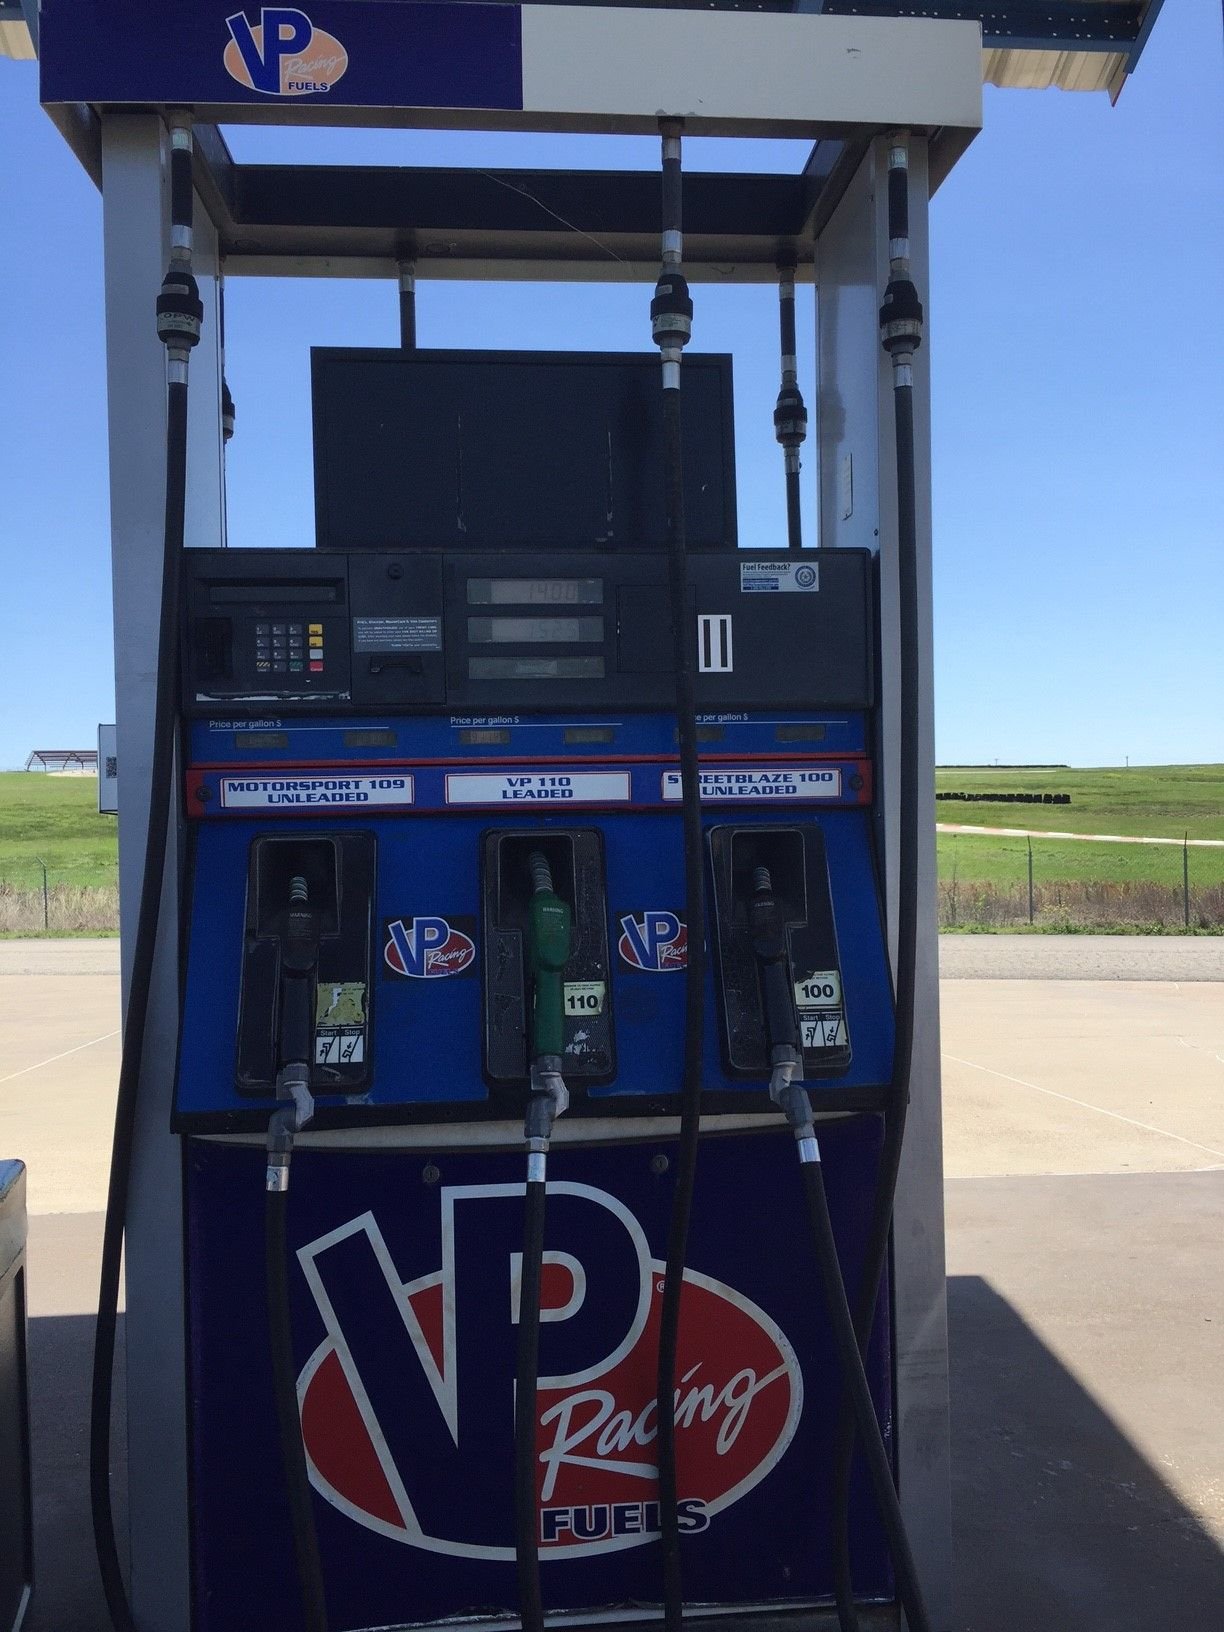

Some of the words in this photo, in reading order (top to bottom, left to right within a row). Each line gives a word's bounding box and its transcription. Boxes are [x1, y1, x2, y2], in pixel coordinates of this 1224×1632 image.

[226, 8, 312, 94] VP
[288, 82, 328, 91] FUELS
[757, 563, 791, 571] Feedback?
[450, 717, 471, 725] Price
[473, 717, 487, 726] per
[488, 716, 513, 726] gallon
[514, 715, 520, 724] $
[703, 714, 716, 722] per
[717, 713, 742, 723] gallon
[743, 712, 749, 721] $
[209, 720, 231, 728] Price
[232, 721, 247, 730] per
[249, 719, 275, 730] gallon
[507, 777, 532, 787] VP
[538, 777, 571, 787] 110
[668, 773, 793, 783] SEETBLAZE
[799, 773, 833, 782] 100
[228, 780, 363, 792] MOTORSPORT
[368, 779, 405, 789] 109
[703, 785, 797, 796] UNLEADED
[267, 792, 369, 804] UNLEADED
[502, 789, 573, 799] LEADED
[388, 917, 450, 976] VP
[621, 911, 680, 970] VP
[427, 948, 473, 969] Racing
[802, 985, 834, 998] 100
[568, 995, 598, 1009] 110
[296, 1180, 652, 1556] VP
[540, 1362, 789, 1502] Racing
